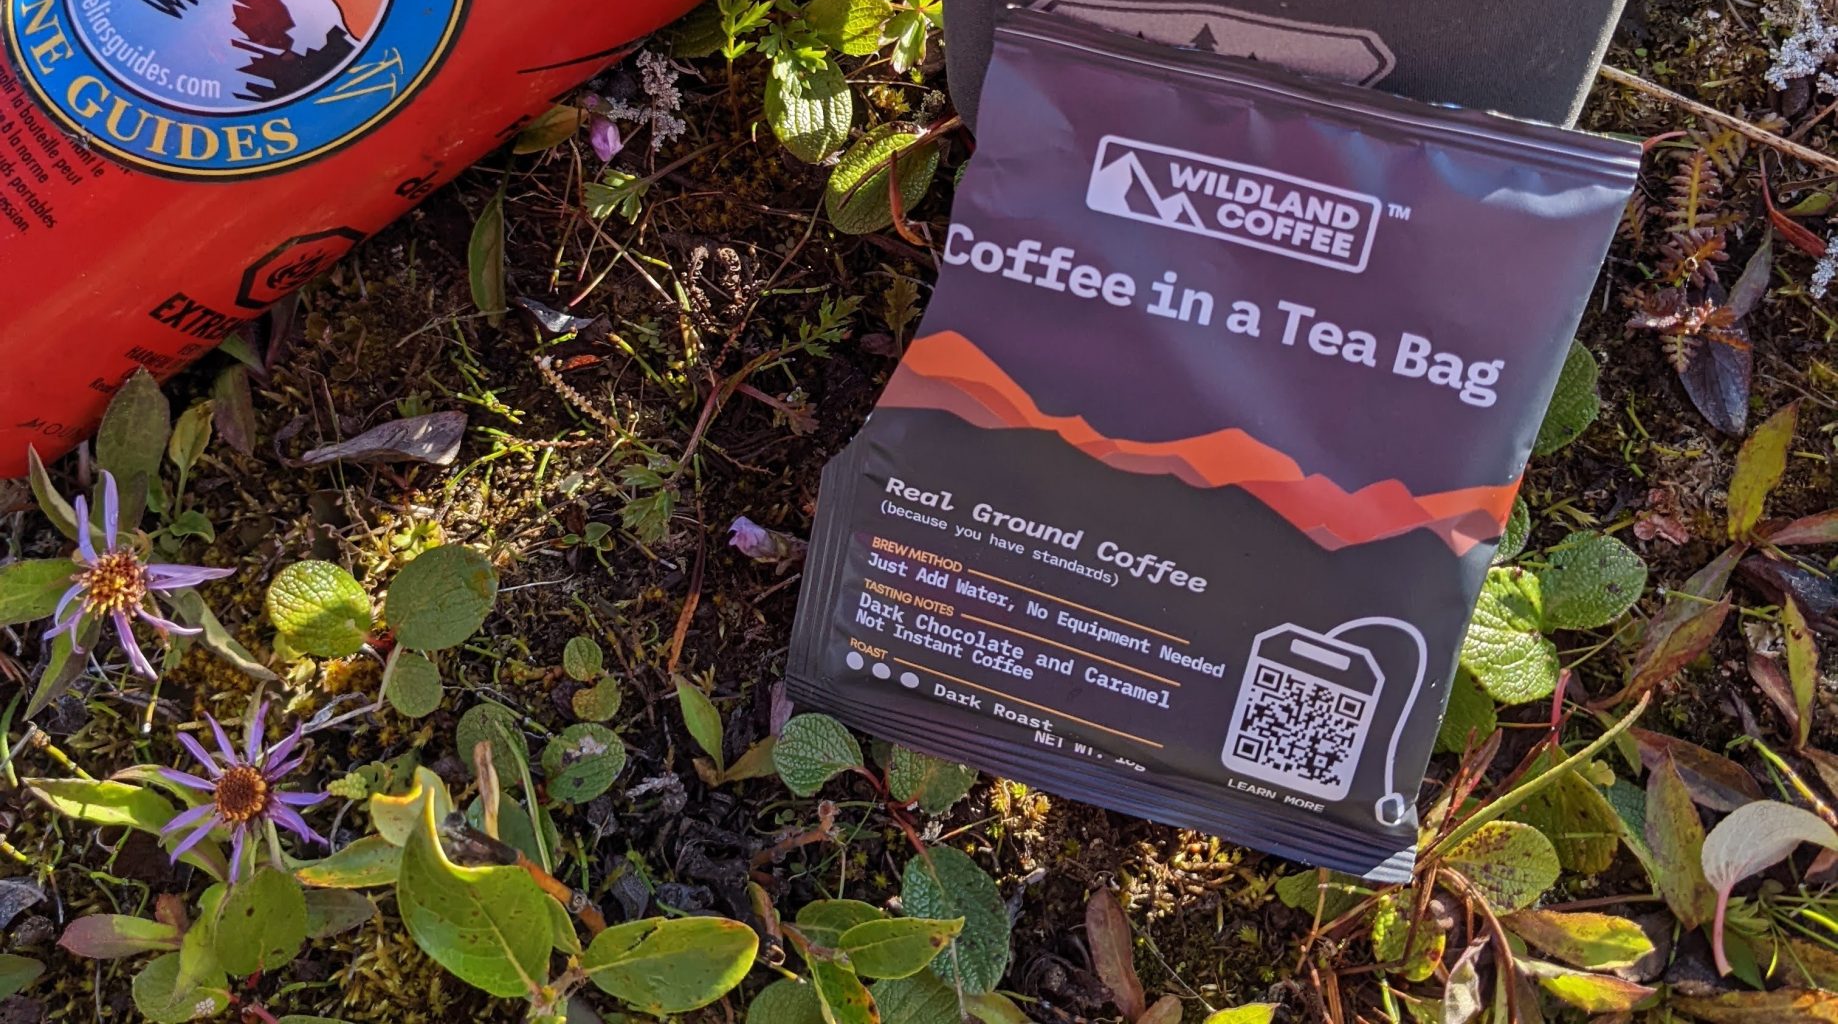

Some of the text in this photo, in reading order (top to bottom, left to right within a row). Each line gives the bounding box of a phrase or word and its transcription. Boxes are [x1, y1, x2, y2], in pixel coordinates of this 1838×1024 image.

[10, 91, 23, 110] la
[18, 103, 60, 158] bouteille
[52, 158, 83, 186] peut
[66, 75, 299, 162] GUIDES
[8, 128, 22, 148] la
[16, 144, 48, 184] norme
[90, 160, 105, 178] le
[8, 176, 58, 228] portables
[1169, 162, 1360, 230] WILDLAND
[1216, 203, 1355, 259] COFFEE
[943, 222, 1506, 409] Coffee in a Tea Bag
[872, 536, 963, 573] BREW METHOD
[880, 499, 1119, 588] (because you have standards)
[885, 477, 1207, 593] Real Ground Coffee
[864, 578, 955, 617] TASTING NOTES
[868, 552, 1226, 678] Just Add Water, No Equipment Needed
[850, 637, 888, 660] ROAST
[856, 609, 1034, 680] Not Instant Coffee
[859, 591, 1170, 709] Dark Chocolate and Caramel
[934, 682, 1053, 733] Dark Roast
[1226, 777, 1326, 814] LEARN MORE
